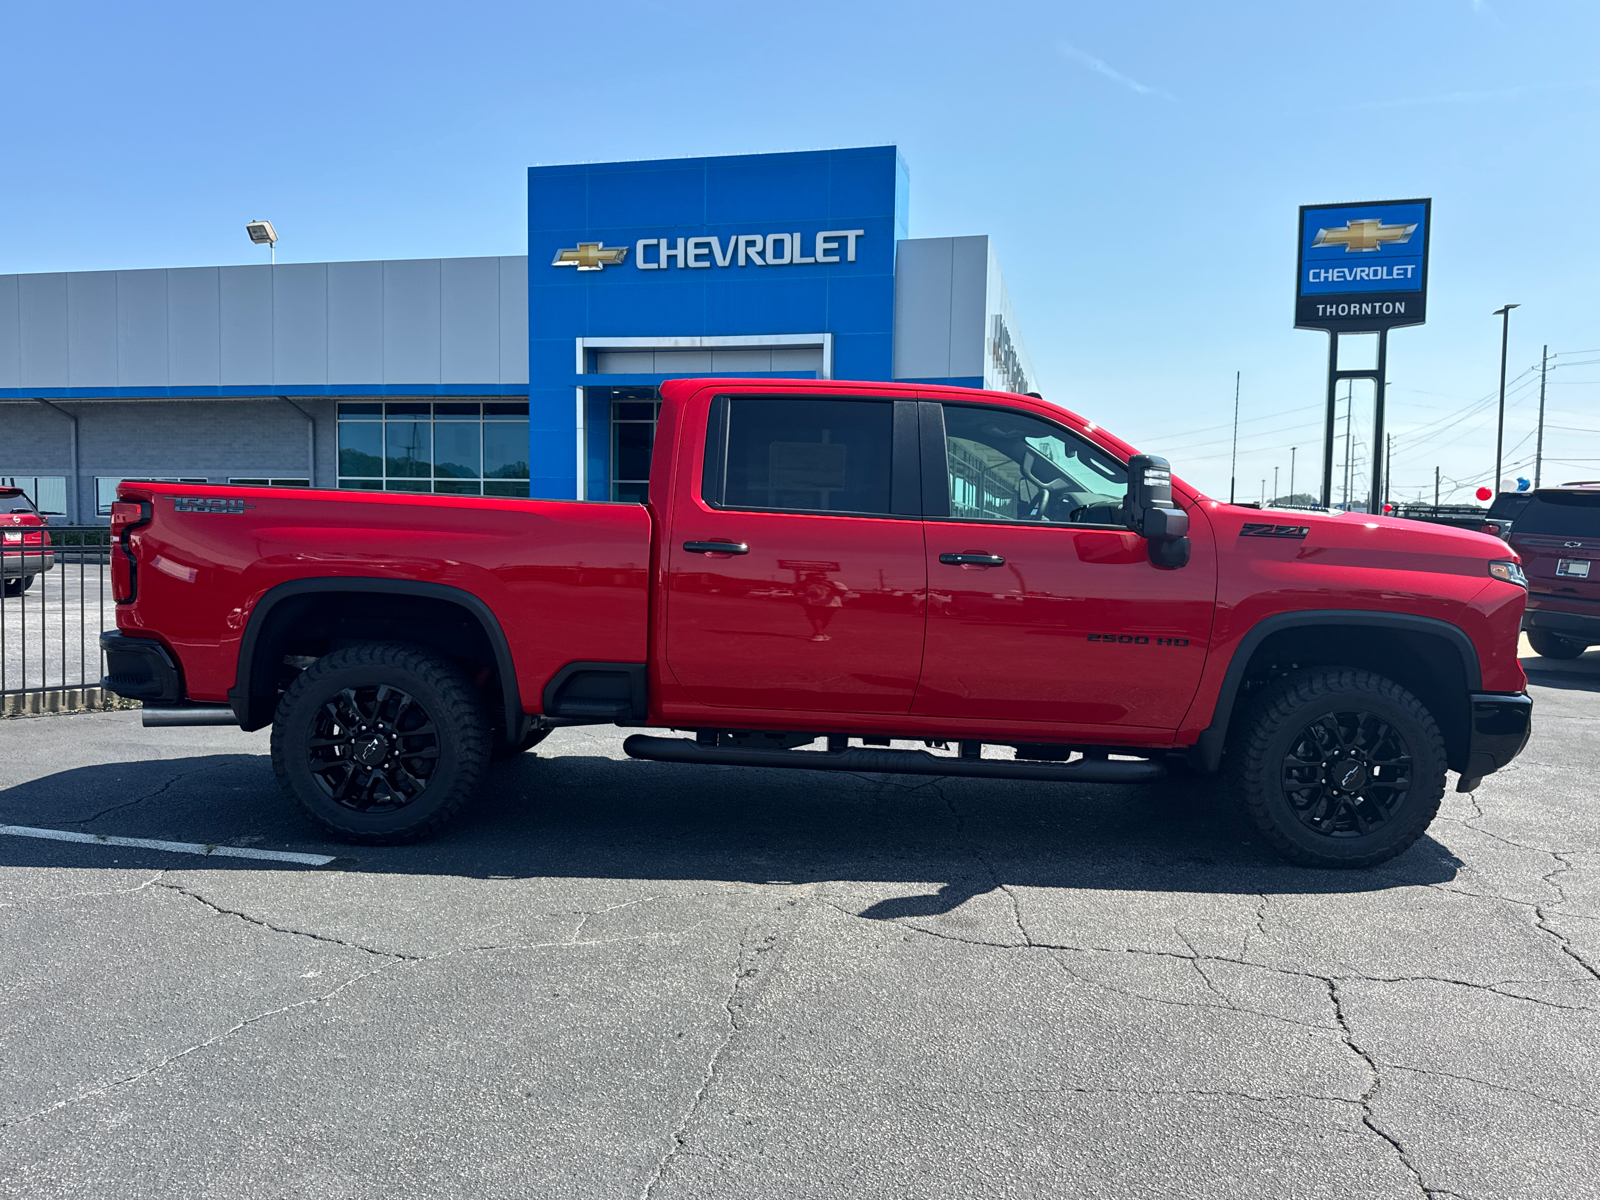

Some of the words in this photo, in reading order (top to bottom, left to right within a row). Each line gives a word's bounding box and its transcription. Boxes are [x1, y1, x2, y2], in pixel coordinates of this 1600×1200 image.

[635, 229, 865, 270] CHEVROLET
[1308, 264, 1416, 283] CHEVROLET
[1316, 301, 1406, 317] THORNTON
[1239, 522, 1311, 540] Z71
[1086, 632, 1150, 645] 2500
[1156, 636, 1190, 648] HD
